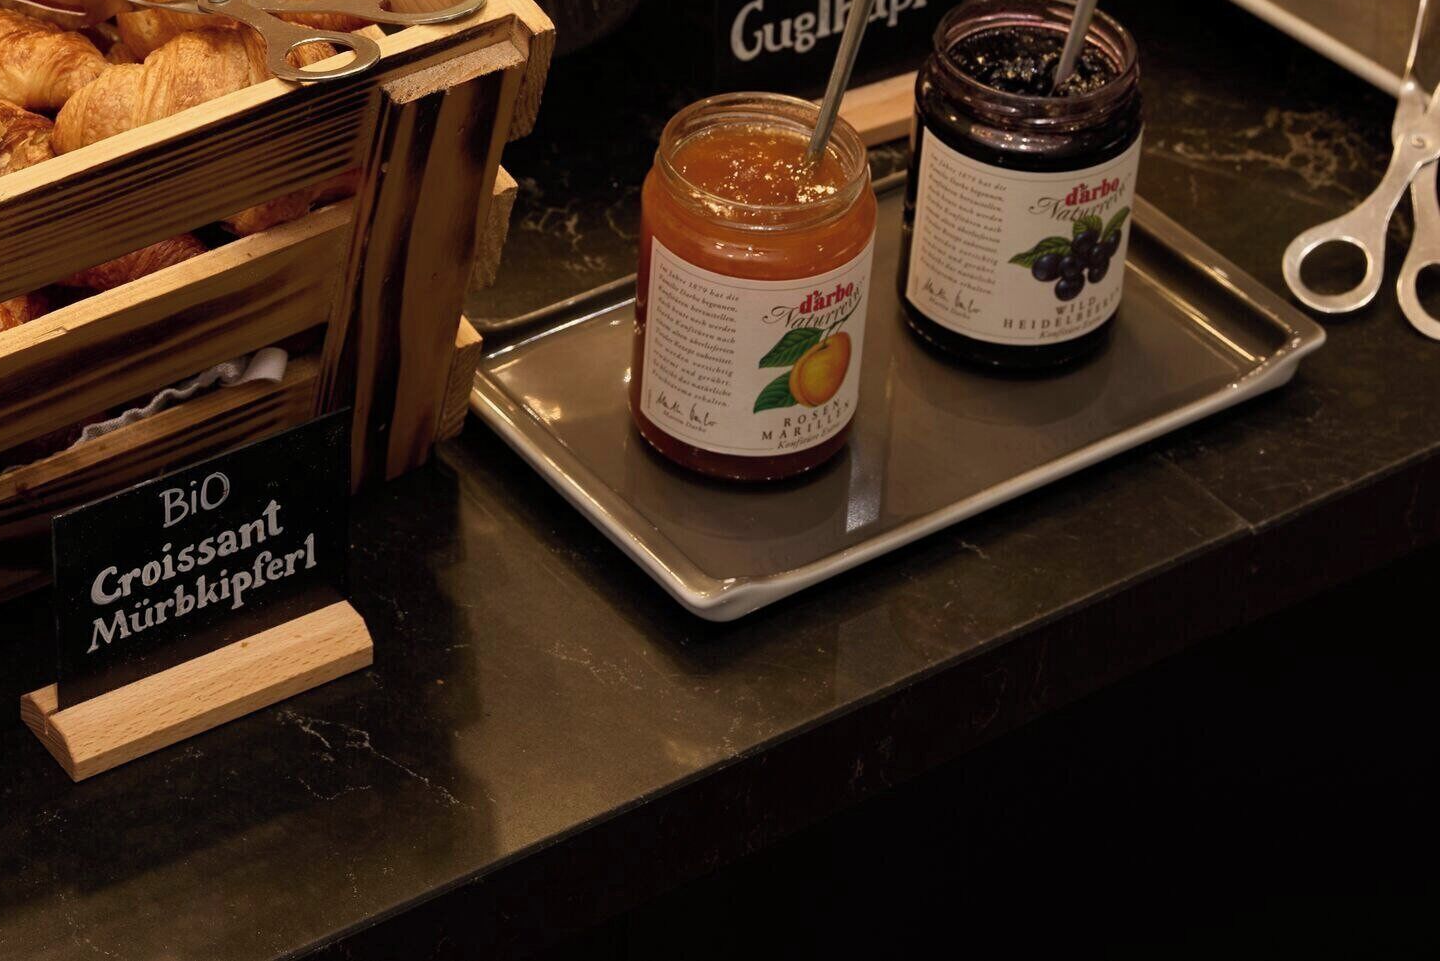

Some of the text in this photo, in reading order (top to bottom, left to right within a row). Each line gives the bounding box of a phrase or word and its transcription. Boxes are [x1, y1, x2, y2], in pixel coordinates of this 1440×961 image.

[90, 499, 284, 605] Croissant
[159, 472, 231, 528] BiO
[86, 533, 317, 653] Mürbkipferl
